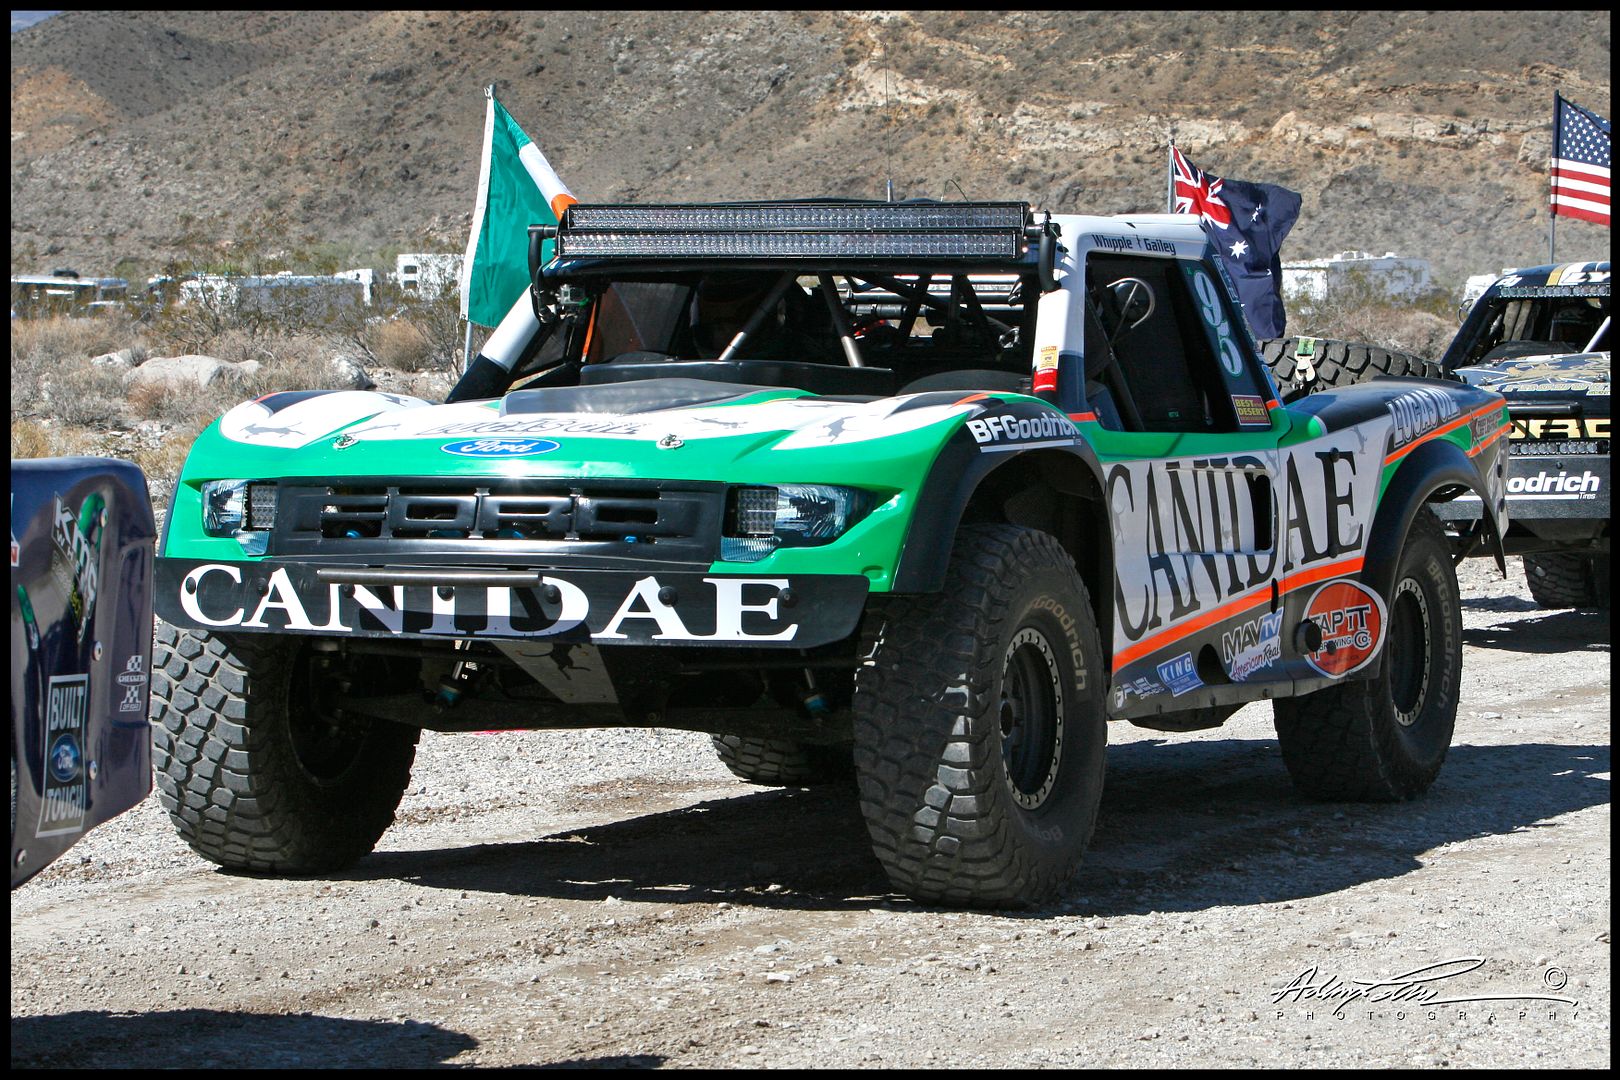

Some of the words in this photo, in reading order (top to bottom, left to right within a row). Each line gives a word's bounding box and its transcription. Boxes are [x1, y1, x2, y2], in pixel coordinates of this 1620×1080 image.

[1092, 234, 1133, 252] Whipple
[1143, 238, 1177, 256] Gailey
[1235, 399, 1253, 408] BEST
[1237, 407, 1265, 416] DESERT
[1385, 388, 1439, 448] LUCAS
[1428, 388, 1460, 422] OIL
[1506, 471, 1600, 492] odrich
[1106, 447, 1365, 642] CANIDAE
[180, 563, 800, 641] CANIDAE
[1029, 596, 1088, 691] Goodrich
[1222, 607, 1284, 664] MAVTV
[1263, 637, 1281, 664] Real
[1319, 636, 1352, 651] BRWING
[1161, 657, 1192, 682] KING
[50, 686, 84, 731] BUILT
[44, 784, 83, 823] TOUGH
